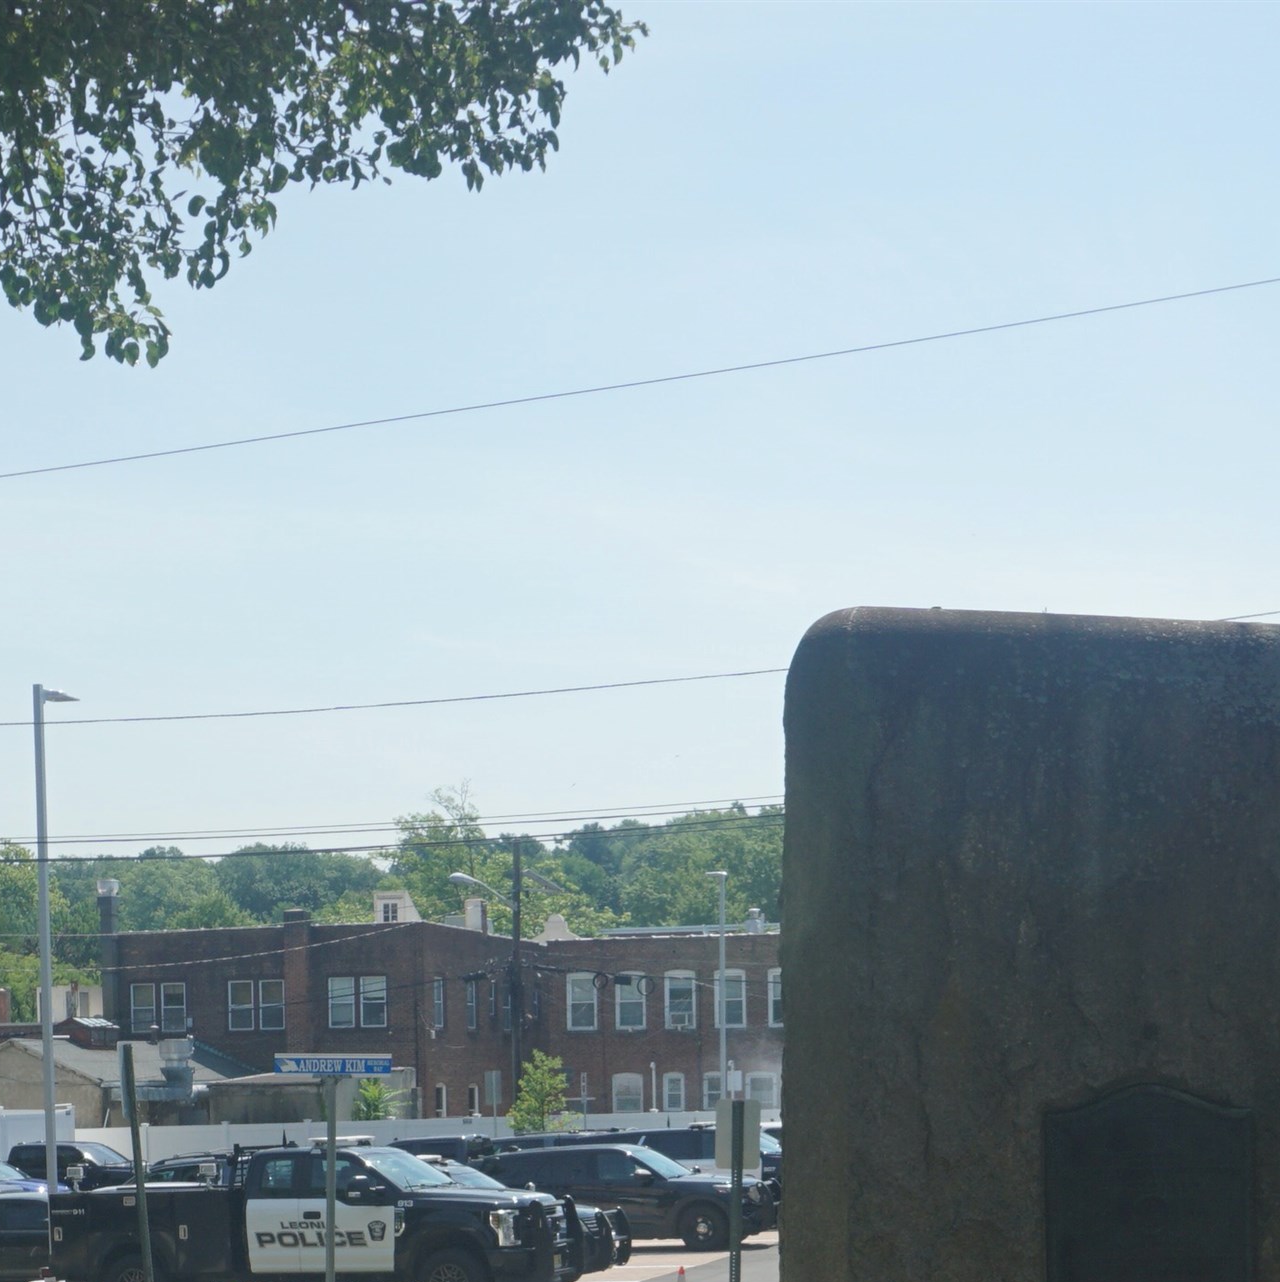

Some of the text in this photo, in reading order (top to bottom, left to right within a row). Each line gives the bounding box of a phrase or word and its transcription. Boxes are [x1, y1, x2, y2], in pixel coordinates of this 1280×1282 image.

[298, 1059, 365, 1073] ANDREW KIM
[254, 1231, 368, 1248] POLICE
